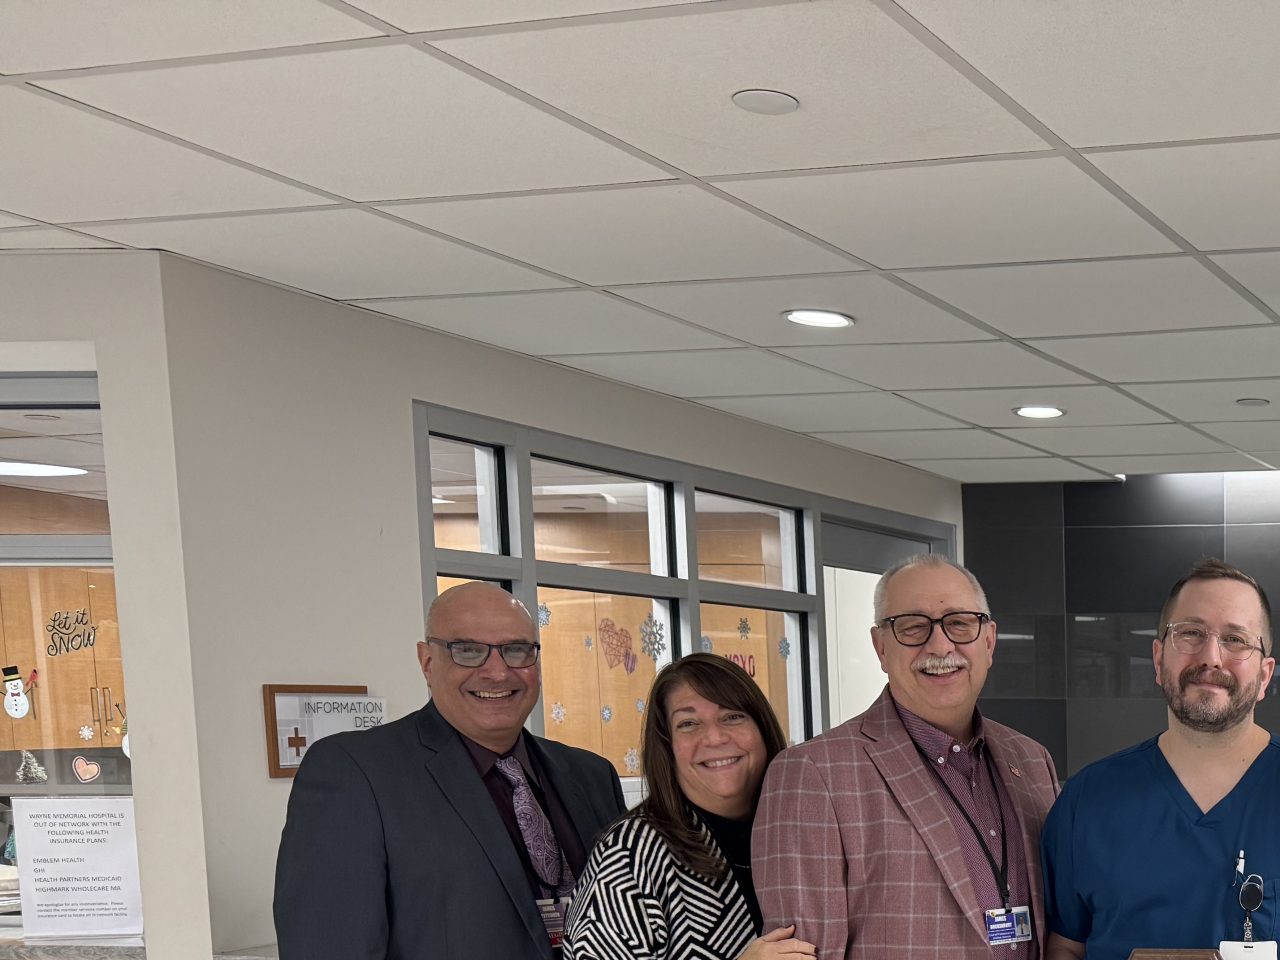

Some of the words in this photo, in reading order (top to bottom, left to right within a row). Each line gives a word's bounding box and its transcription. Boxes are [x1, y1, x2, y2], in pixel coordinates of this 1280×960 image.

[46, 611, 76, 635] Let
[74, 608, 88, 625] it
[47, 625, 98, 656] SNOW
[305, 702, 382, 713] INFORMATION
[355, 717, 382, 727] DESK
